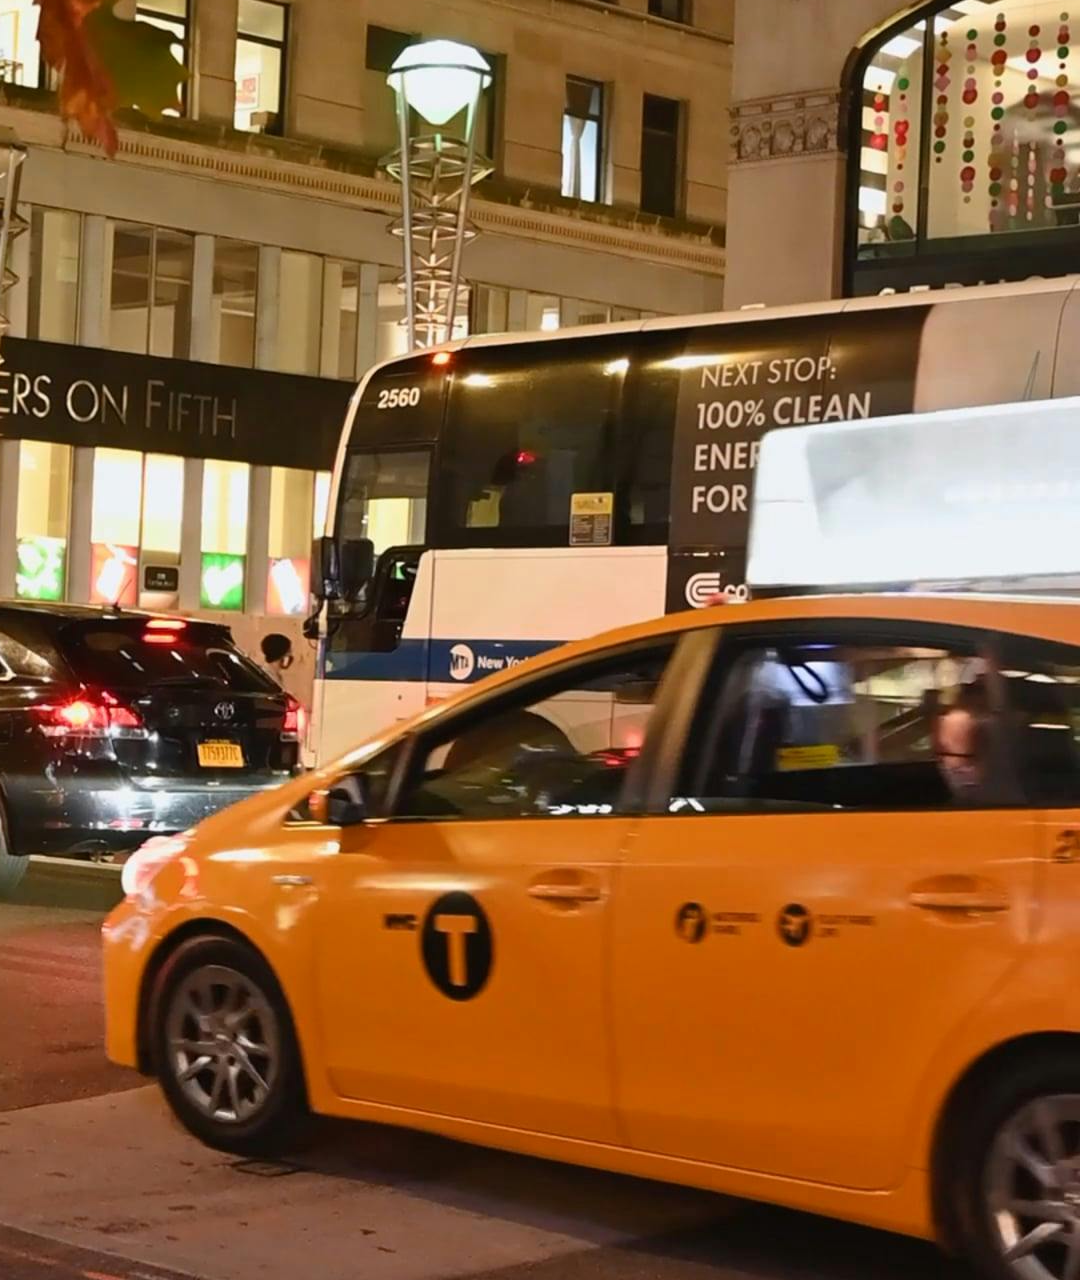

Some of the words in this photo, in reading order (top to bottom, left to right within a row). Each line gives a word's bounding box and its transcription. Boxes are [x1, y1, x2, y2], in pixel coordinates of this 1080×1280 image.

[701, 361, 763, 389] NEXT
[767, 356, 837, 384] STOP:
[66, 380, 128, 425] ON
[145, 379, 238, 439] FIFTH
[377, 387, 420, 409] 2560
[697, 399, 766, 430] 100%
[773, 392, 871, 425] CLEAN
[692, 484, 748, 513] FOR
[477, 655, 504, 670] New
[435, 913, 478, 987] T
